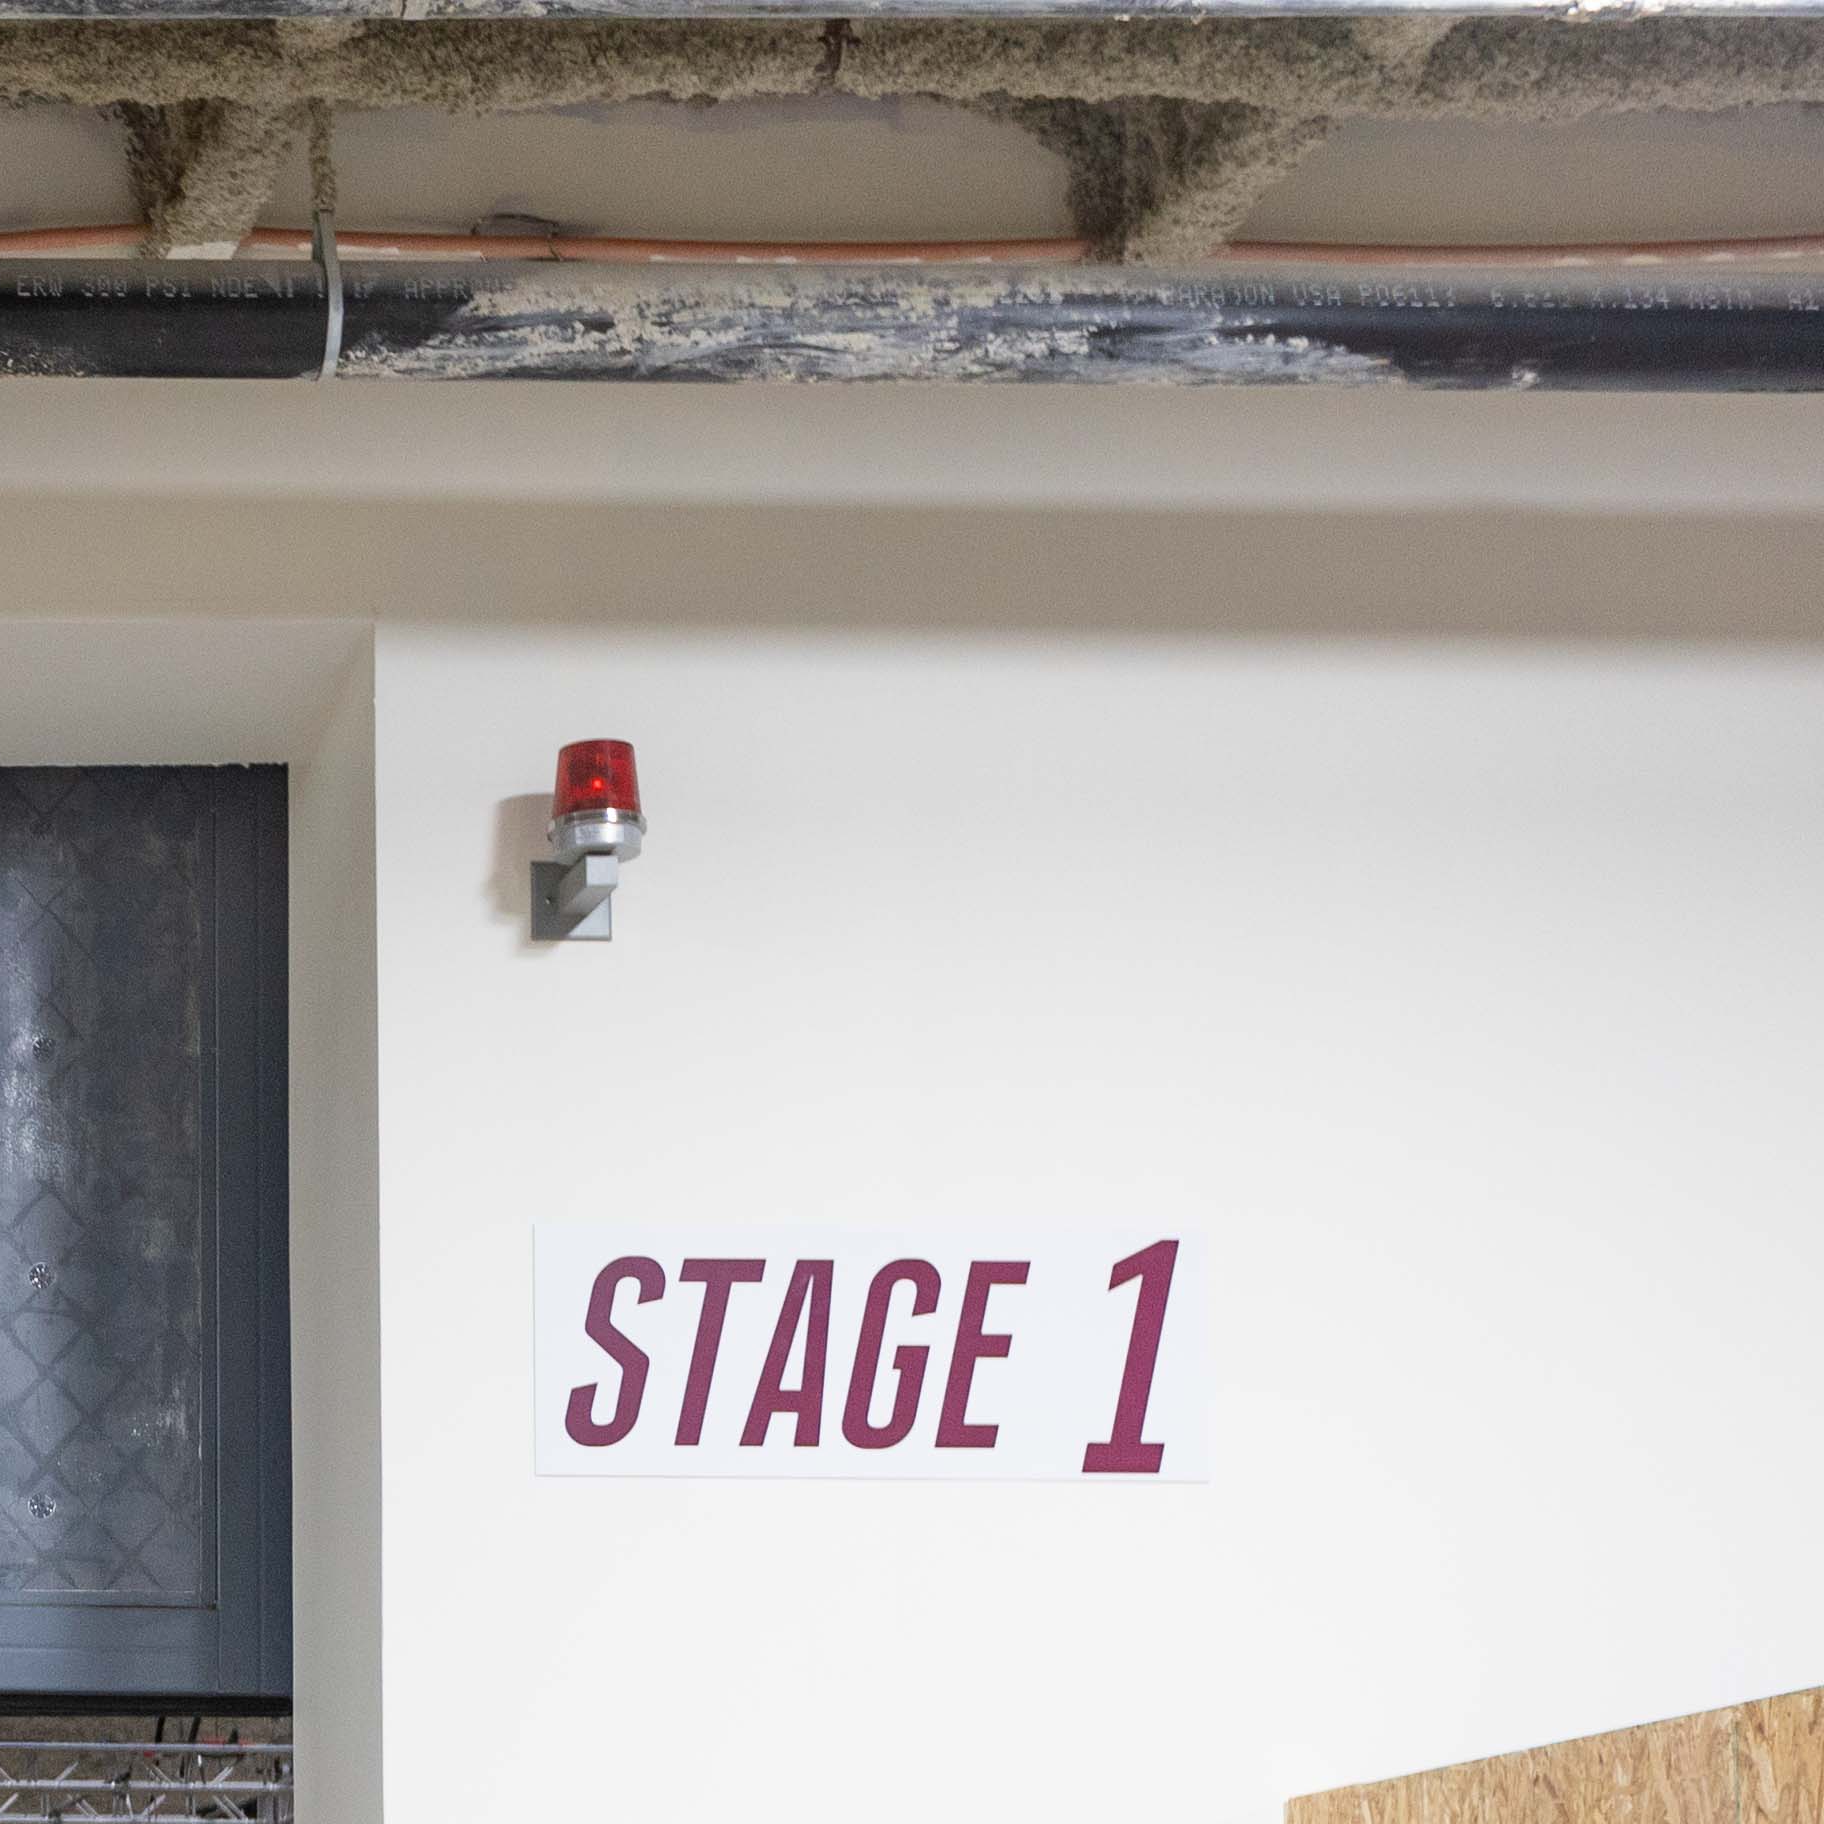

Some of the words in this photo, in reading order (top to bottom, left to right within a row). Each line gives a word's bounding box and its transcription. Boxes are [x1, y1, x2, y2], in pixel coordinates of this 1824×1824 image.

[15, 275, 64, 298] ERW
[145, 275, 192, 298] PSI
[564, 1255, 1031, 1450] STAGE
[1081, 1239, 1180, 1474] 1
